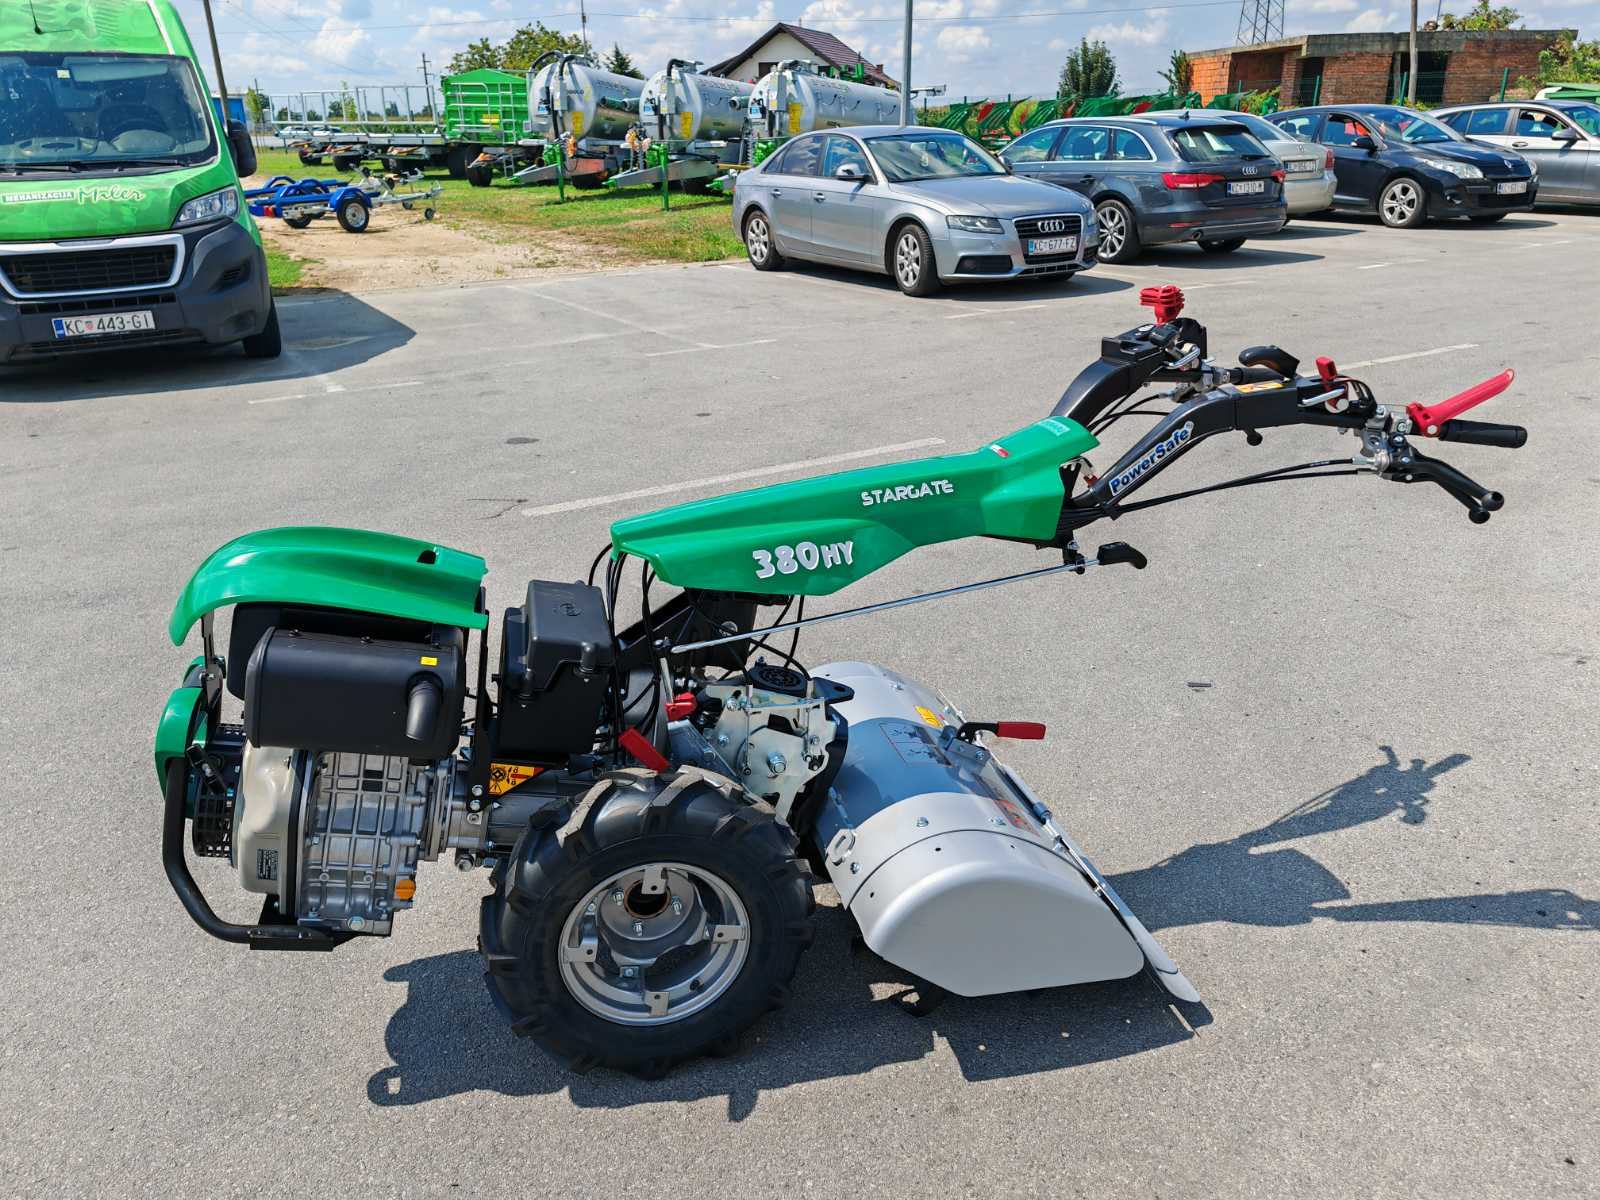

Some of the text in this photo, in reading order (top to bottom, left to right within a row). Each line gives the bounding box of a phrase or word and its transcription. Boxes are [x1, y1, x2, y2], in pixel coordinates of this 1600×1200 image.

[4, 190, 73, 203] MEHANIZACIJA
[64, 313, 150, 335] KC 443-GI
[1110, 428, 1189, 494] PowerSafe
[861, 479, 954, 507] STARGATE
[752, 540, 854, 579] 380HY
